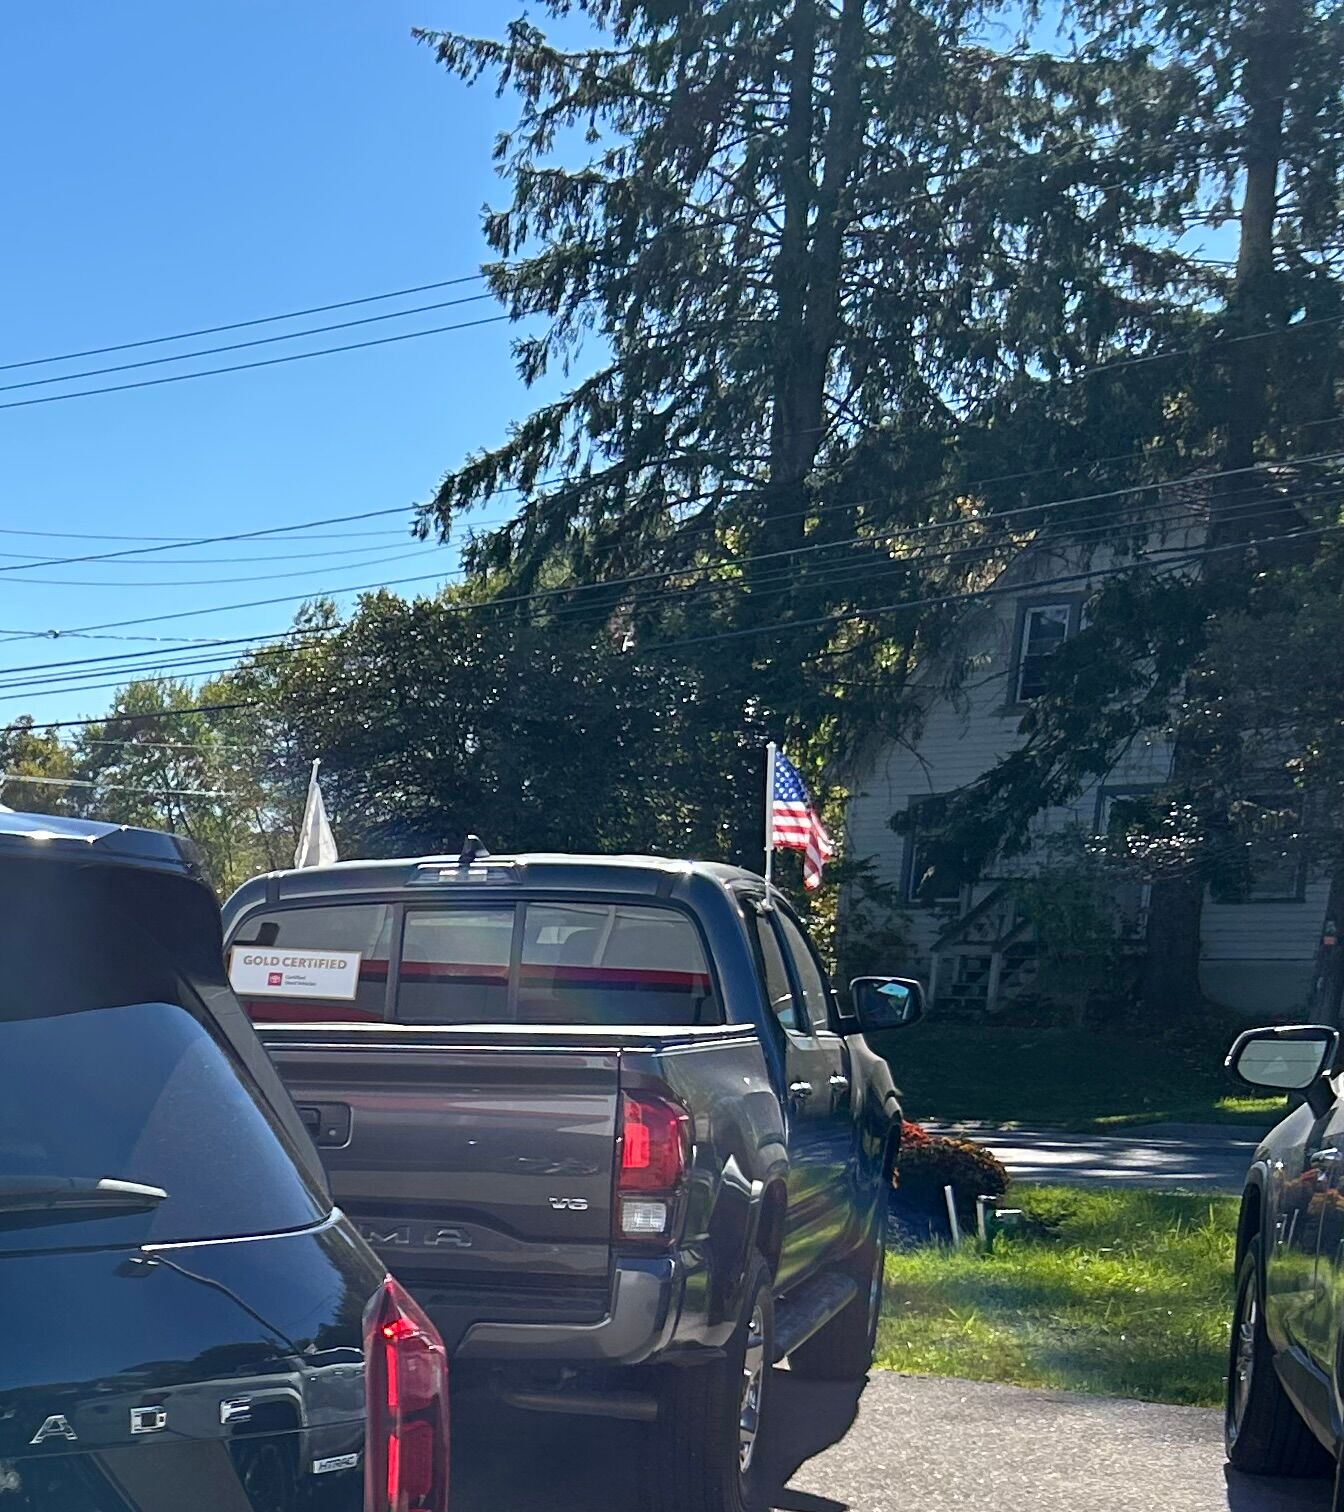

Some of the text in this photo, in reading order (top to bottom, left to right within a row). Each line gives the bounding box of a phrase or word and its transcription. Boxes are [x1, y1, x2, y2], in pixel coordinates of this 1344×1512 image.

[243, 955, 347, 970] GOLD CERTIFIED
[548, 1197, 589, 1211] V6
